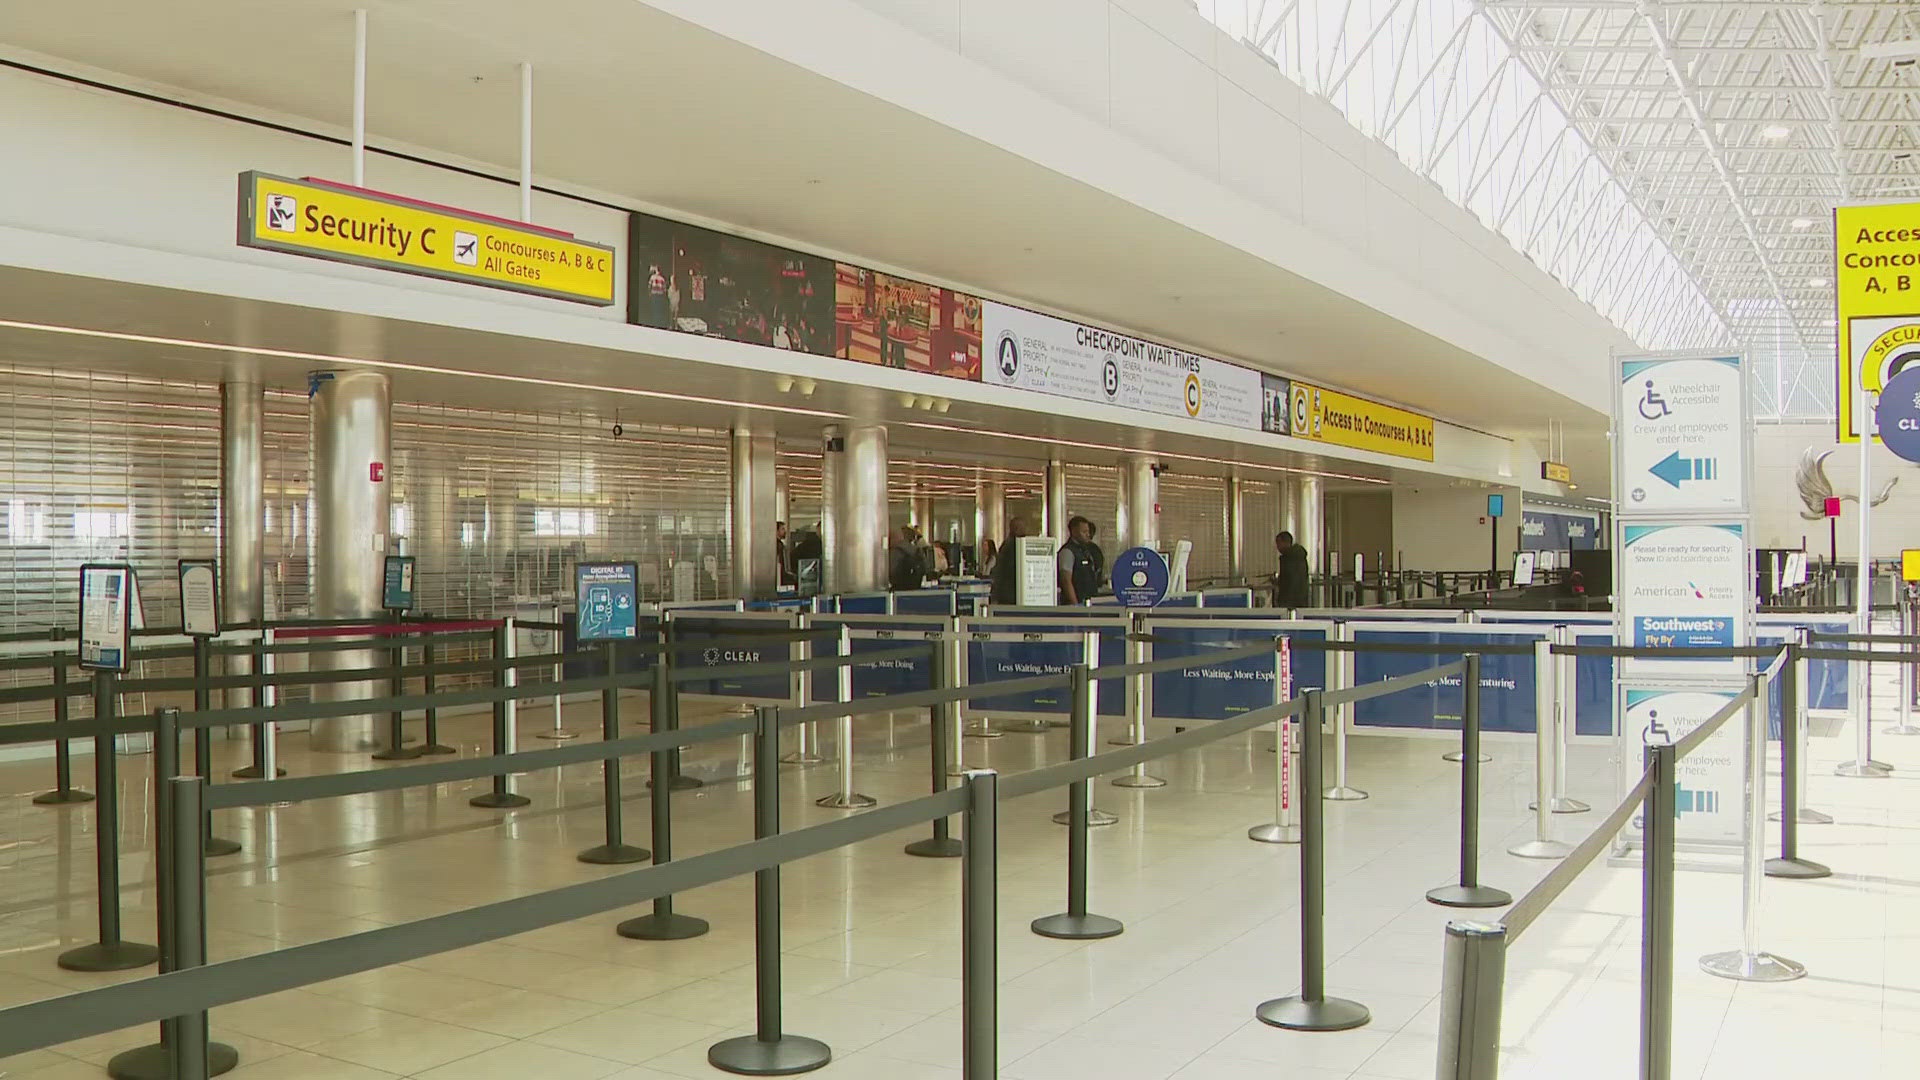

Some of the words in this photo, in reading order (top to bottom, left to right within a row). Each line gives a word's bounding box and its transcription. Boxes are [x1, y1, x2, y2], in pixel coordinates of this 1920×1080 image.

[305, 205, 412, 256] Security
[420, 228, 436, 254] C
[485, 235, 555, 263] Concourses
[559, 251, 571, 268] A,
[575, 253, 583, 268] B
[586, 255, 594, 269] &
[597, 257, 605, 272] C
[1844, 252, 1920, 269] Conco
[484, 256, 502, 272] All
[506, 261, 540, 280] Gates
[1865, 277, 1887, 294] A,
[1897, 275, 1911, 291] B
[1023, 338, 1048, 352] GENERAL
[1076, 327, 1146, 361] CHECKPOINT
[1148, 344, 1173, 367] WAIT
[1174, 350, 1201, 374] TIMES
[1001, 340, 1016, 371] A
[1023, 350, 1048, 364] PRIORITY
[1105, 364, 1117, 390] B
[1188, 384, 1196, 406] C
[1669, 384, 1720, 394] Wheelchair
[1672, 395, 1720, 405] Accessible
[1297, 398, 1304, 422] C
[1323, 406, 1352, 431] Access
[1354, 414, 1362, 433] to
[1364, 416, 1405, 442] Concourses
[1407, 426, 1414, 447] A,
[1415, 429, 1420, 444] B
[1421, 430, 1427, 446] &
[1634, 424, 1657, 434] Crew
[1660, 424, 1676, 433] and
[1678, 422, 1728, 435] employees
[1657, 435, 1681, 444] enter
[1633, 545, 1656, 553] Please
[1657, 545, 1667, 553] be
[1668, 546, 1688, 554] ready
[1690, 545, 1700, 553] for
[1635, 555, 1654, 563] Show
[1681, 555, 1713, 564] boarding
[590, 567, 615, 575] DIGITAL
[1634, 586, 1687, 597] American
[1709, 586, 1733, 594] Priority
[596, 604, 605, 612] ID
[1643, 618, 1715, 632] Southwest
[1645, 635, 1660, 647] Fly
[724, 651, 760, 663] CLEAR
[879, 660, 894, 669] More
[895, 660, 914, 671] Doing
[998, 663, 1013, 672] Less
[1014, 663, 1043, 675] Waiting,
[1044, 664, 1062, 674] More
[1183, 669, 1200, 678] Less
[1201, 669, 1233, 681] Waiting,
[1234, 671, 1254, 680] More
[1439, 676, 1461, 686] More
[1681, 756, 1732, 766] employees
